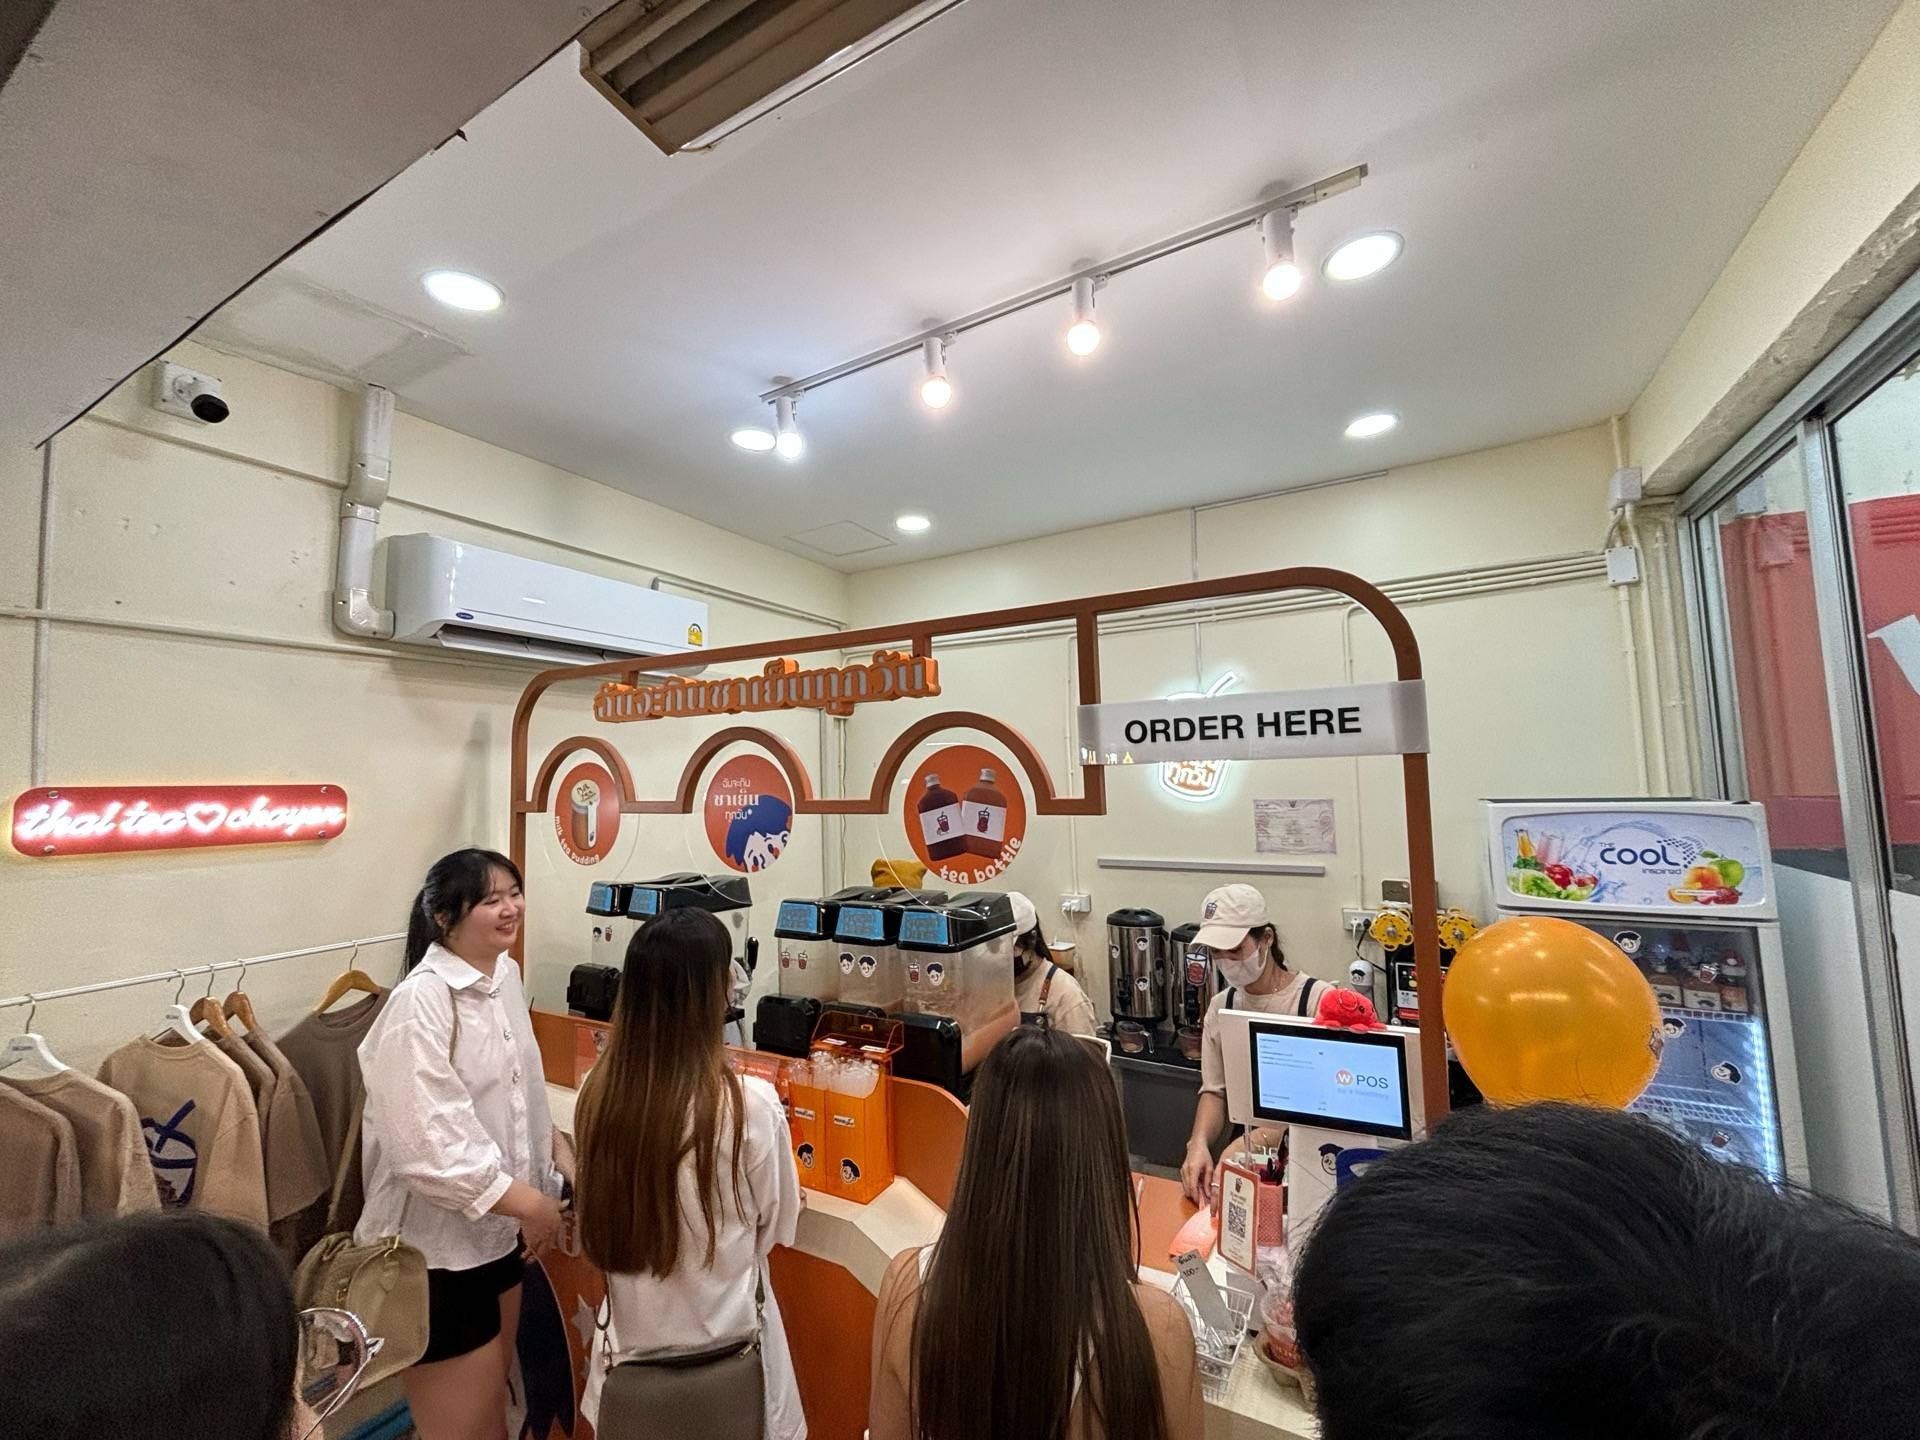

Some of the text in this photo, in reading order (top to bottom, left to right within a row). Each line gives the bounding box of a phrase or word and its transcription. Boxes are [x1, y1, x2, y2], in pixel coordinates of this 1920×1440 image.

[1124, 706, 1363, 745] ORDER HERE
[714, 788, 759, 806] ชาเย็น
[120, 801, 187, 834] tea
[560, 838, 571, 854] tea
[571, 852, 600, 865] pudding
[940, 836, 1022, 884] tea bottle
[1356, 1074, 1389, 1089] POS
